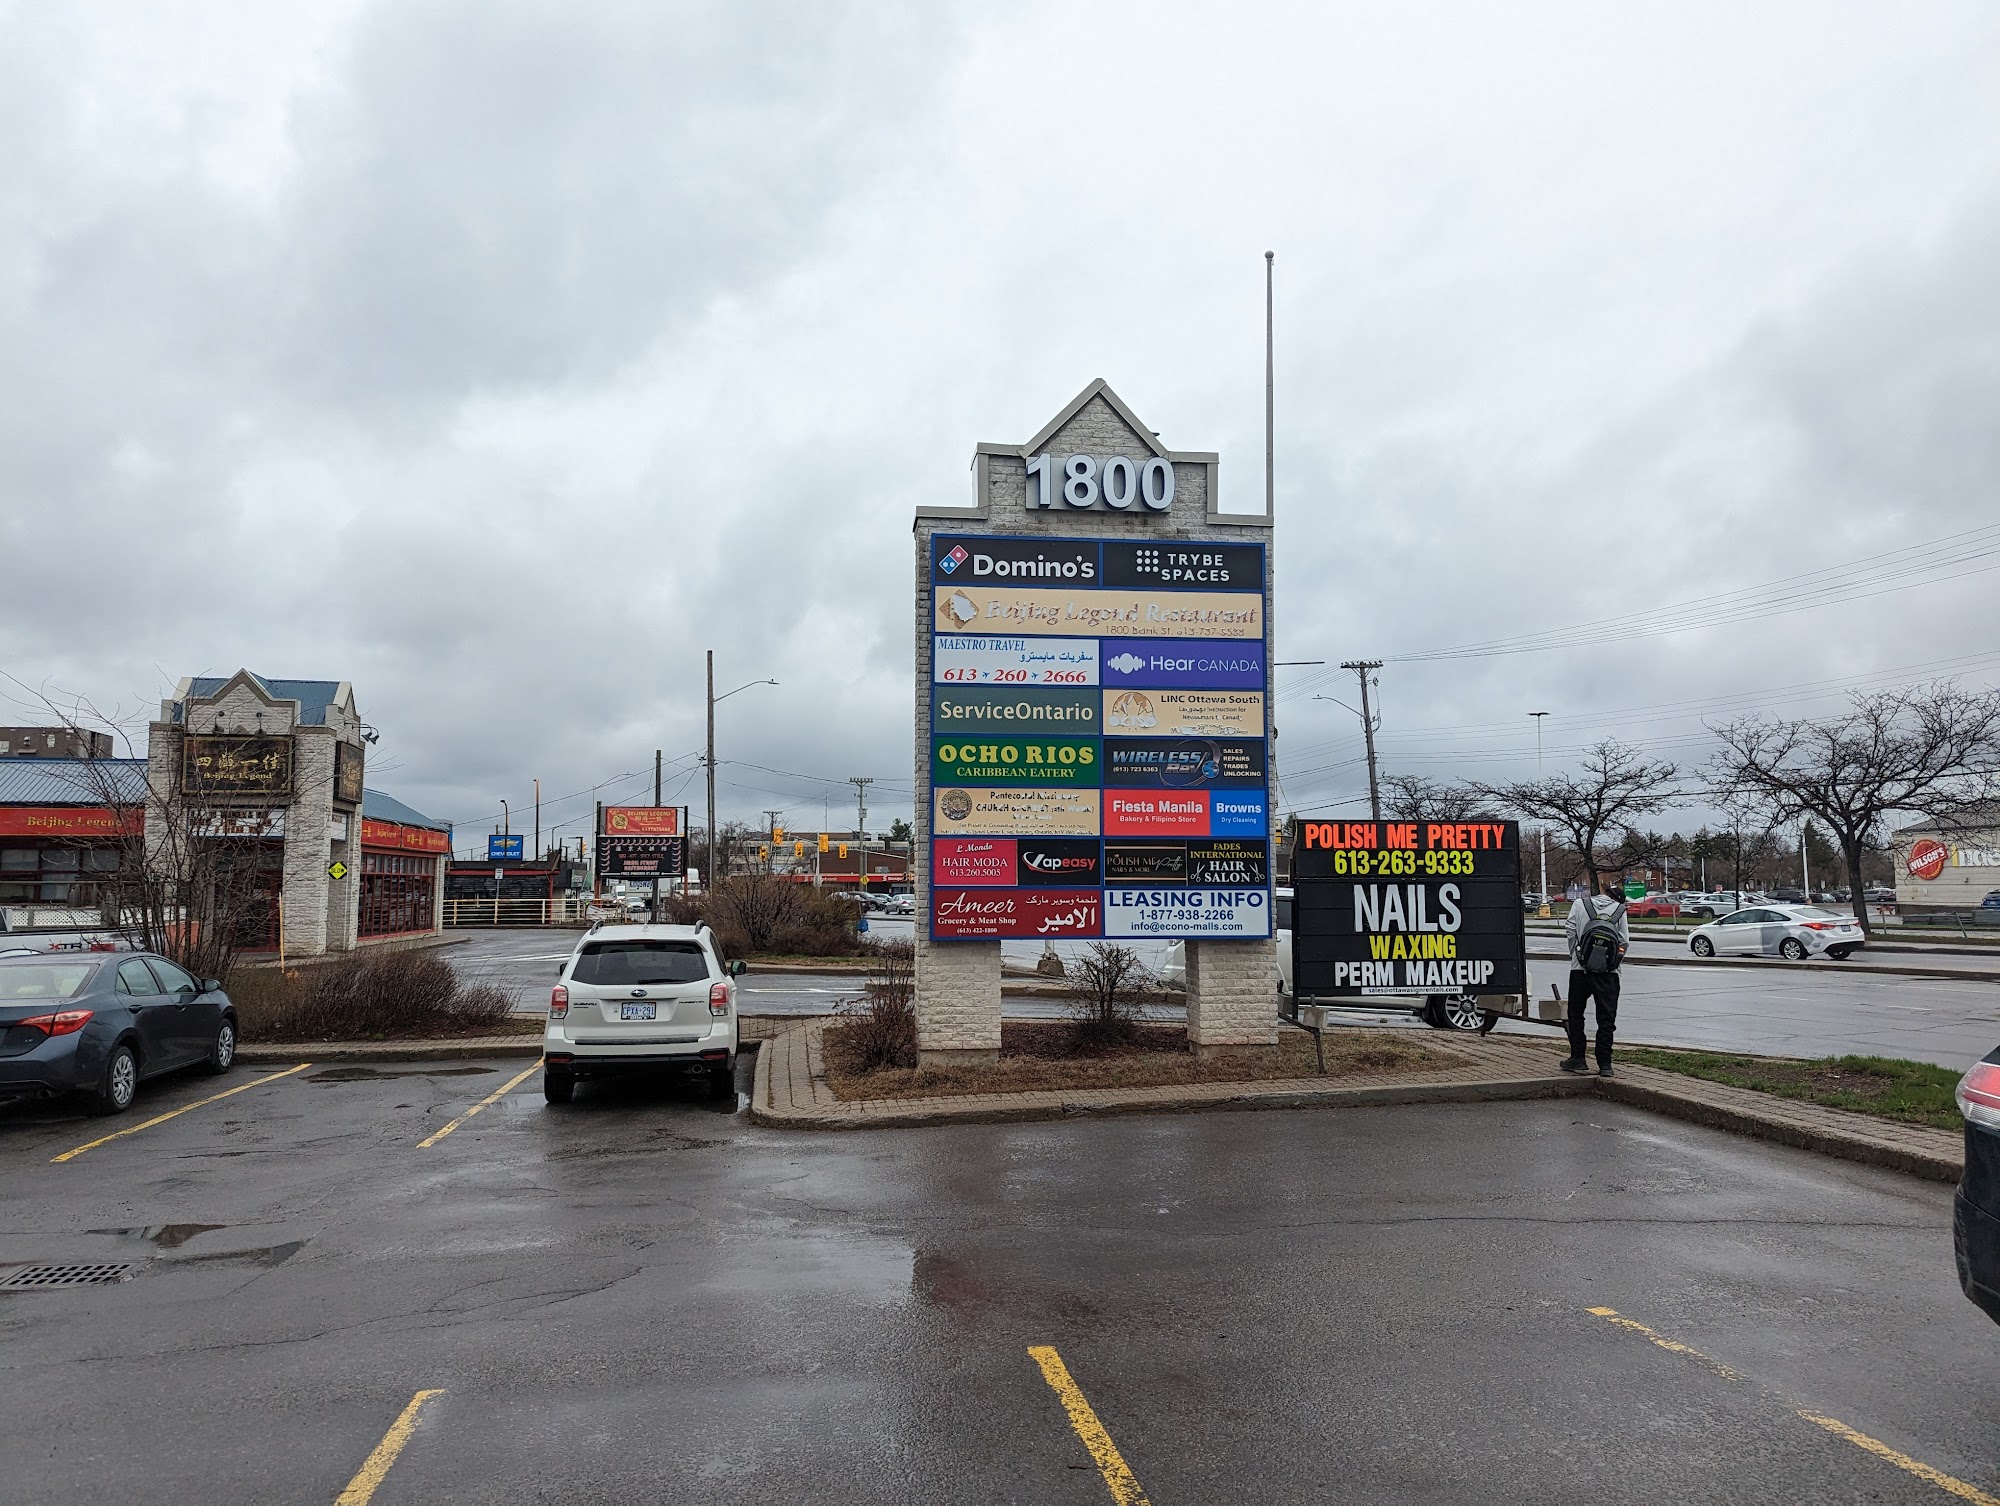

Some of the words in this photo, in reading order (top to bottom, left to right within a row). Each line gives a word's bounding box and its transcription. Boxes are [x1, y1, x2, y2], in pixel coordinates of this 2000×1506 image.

[1026, 453, 1176, 511] 1800
[1167, 553, 1224, 566] TRYBE
[973, 554, 1095, 578] Domino's
[1161, 569, 1230, 581] SPACES
[1105, 625, 1130, 635] 1800
[938, 638, 987, 651] MAESTRO
[988, 639, 1027, 651] TRAVEL
[1018, 651, 1056, 663] مايسترو
[1058, 651, 1094, 663] سفريات
[1150, 656, 1196, 671] Hear
[1197, 659, 1260, 672] CANADA
[943, 667, 978, 681] 613
[993, 669, 1027, 682] 260
[1042, 670, 1088, 683] 2666
[1160, 695, 1185, 703] LINC
[1187, 695, 1226, 704] Ottawa
[1228, 695, 1260, 704] South
[940, 701, 1093, 720] ServiceOntario
[939, 744, 1019, 763] OCHO
[1025, 745, 1094, 764] RIOS
[1112, 750, 1202, 763] WIRELESS
[956, 766, 1027, 777] CARIBBEAN
[1029, 767, 1077, 778] EATERY
[1113, 800, 1154, 813] Fiesta
[1158, 800, 1203, 814] Manila
[1216, 803, 1262, 814] Browns
[27, 816, 73, 828] Beijing
[1119, 815, 1143, 823] Bakery
[1151, 815, 1177, 823] Filipino
[1221, 816, 1232, 824] Dry
[1232, 816, 1257, 824] Cleaning
[1305, 823, 1377, 849] POLISH
[1386, 824, 1418, 849] ME
[1427, 824, 1505, 849] PRETTY
[1190, 850, 1265, 859] INTERNATIONAL
[1909, 847, 1946, 872] WILSON'S
[942, 857, 970, 867] HAIR
[973, 858, 1008, 867] MODA
[1107, 856, 1140, 866] POLISH
[1209, 860, 1246, 871] HAIR
[1334, 850, 1475, 875] 613-263-9333
[1204, 872, 1251, 883] SALON
[937, 891, 1017, 916] Ameer
[1075, 894, 1098, 904] ملحمة
[1109, 892, 1203, 907] LEASING
[1210, 892, 1264, 907] INFO
[1353, 883, 1462, 933] NAILS
[1139, 909, 1234, 920] 1-877-938-2266
[937, 917, 968, 926] Grocery
[969, 917, 977, 925] &
[978, 917, 997, 925] Meat
[998, 917, 1017, 926] Shop
[1131, 921, 1243, 932] info@econo-malls.com
[956, 927, 972, 935] (613)
[1369, 934, 1457, 960] WAXING
[1334, 961, 1394, 987] PERM
[1405, 960, 1495, 985] MAKEUP
